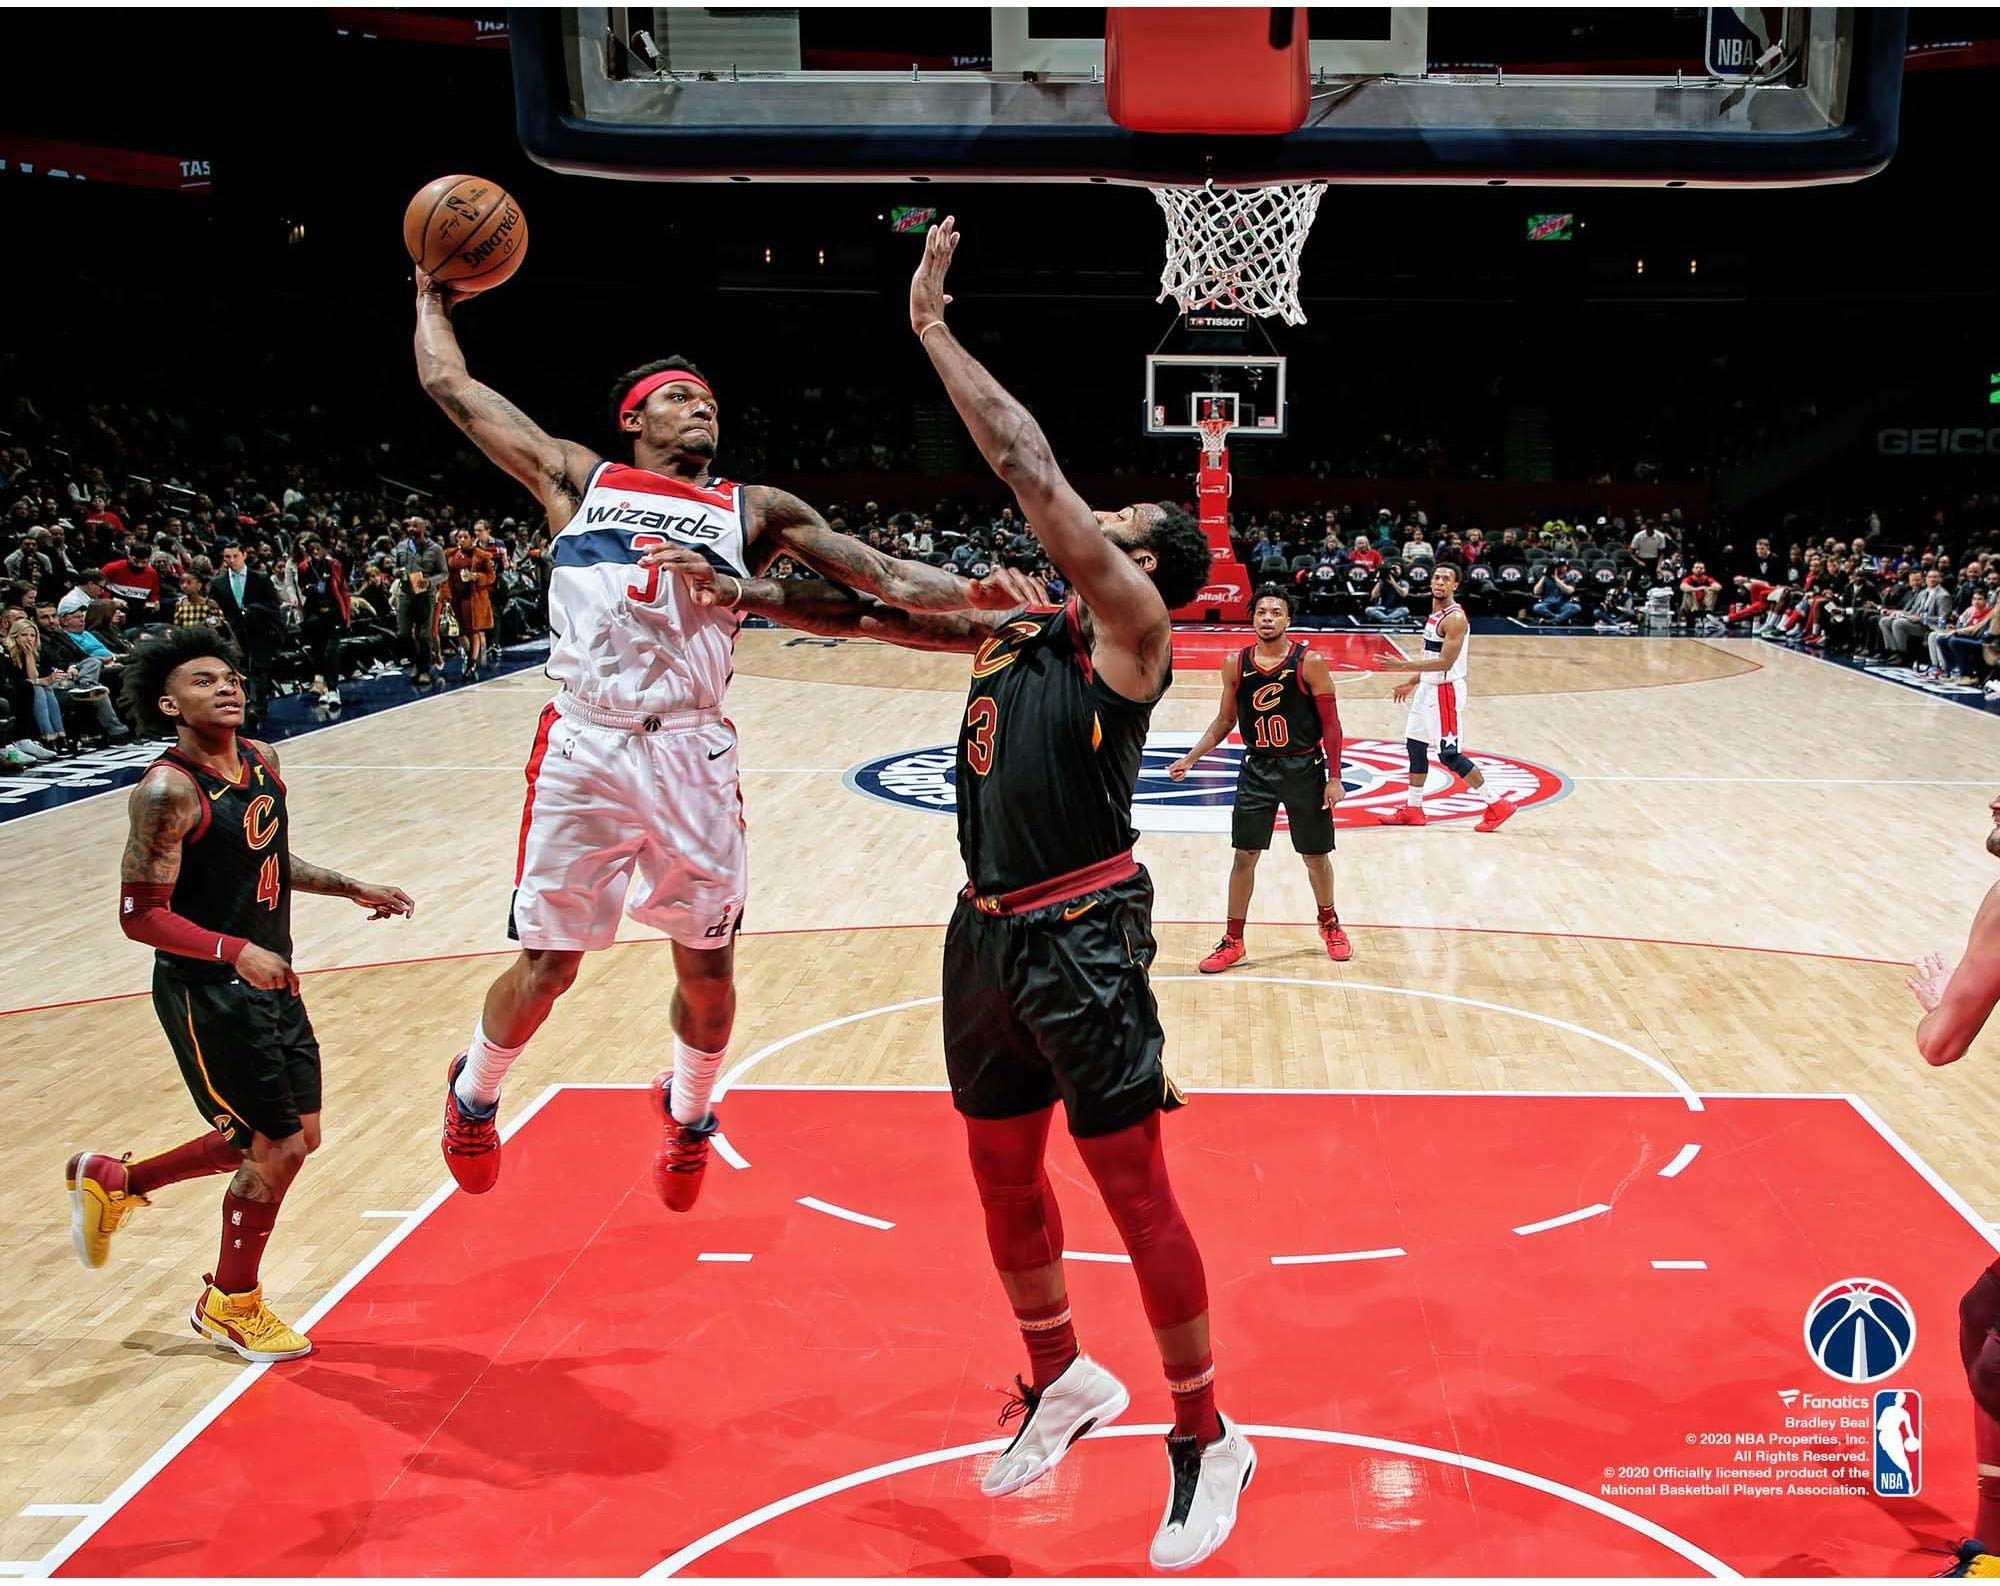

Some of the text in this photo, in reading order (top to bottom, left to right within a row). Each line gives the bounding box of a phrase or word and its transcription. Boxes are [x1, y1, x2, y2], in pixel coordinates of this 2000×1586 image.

[1718, 38, 1754, 66] NBA
[462, 202, 520, 269] SPALDING
[1205, 317, 1246, 327] TISSOT
[586, 501, 726, 540] wizards
[1253, 682, 1285, 712] C
[967, 696, 998, 776] 3
[1254, 714, 1290, 748] 10
[877, 748, 957, 804] IZARDS
[243, 794, 279, 850] C
[257, 853, 280, 911] 4
